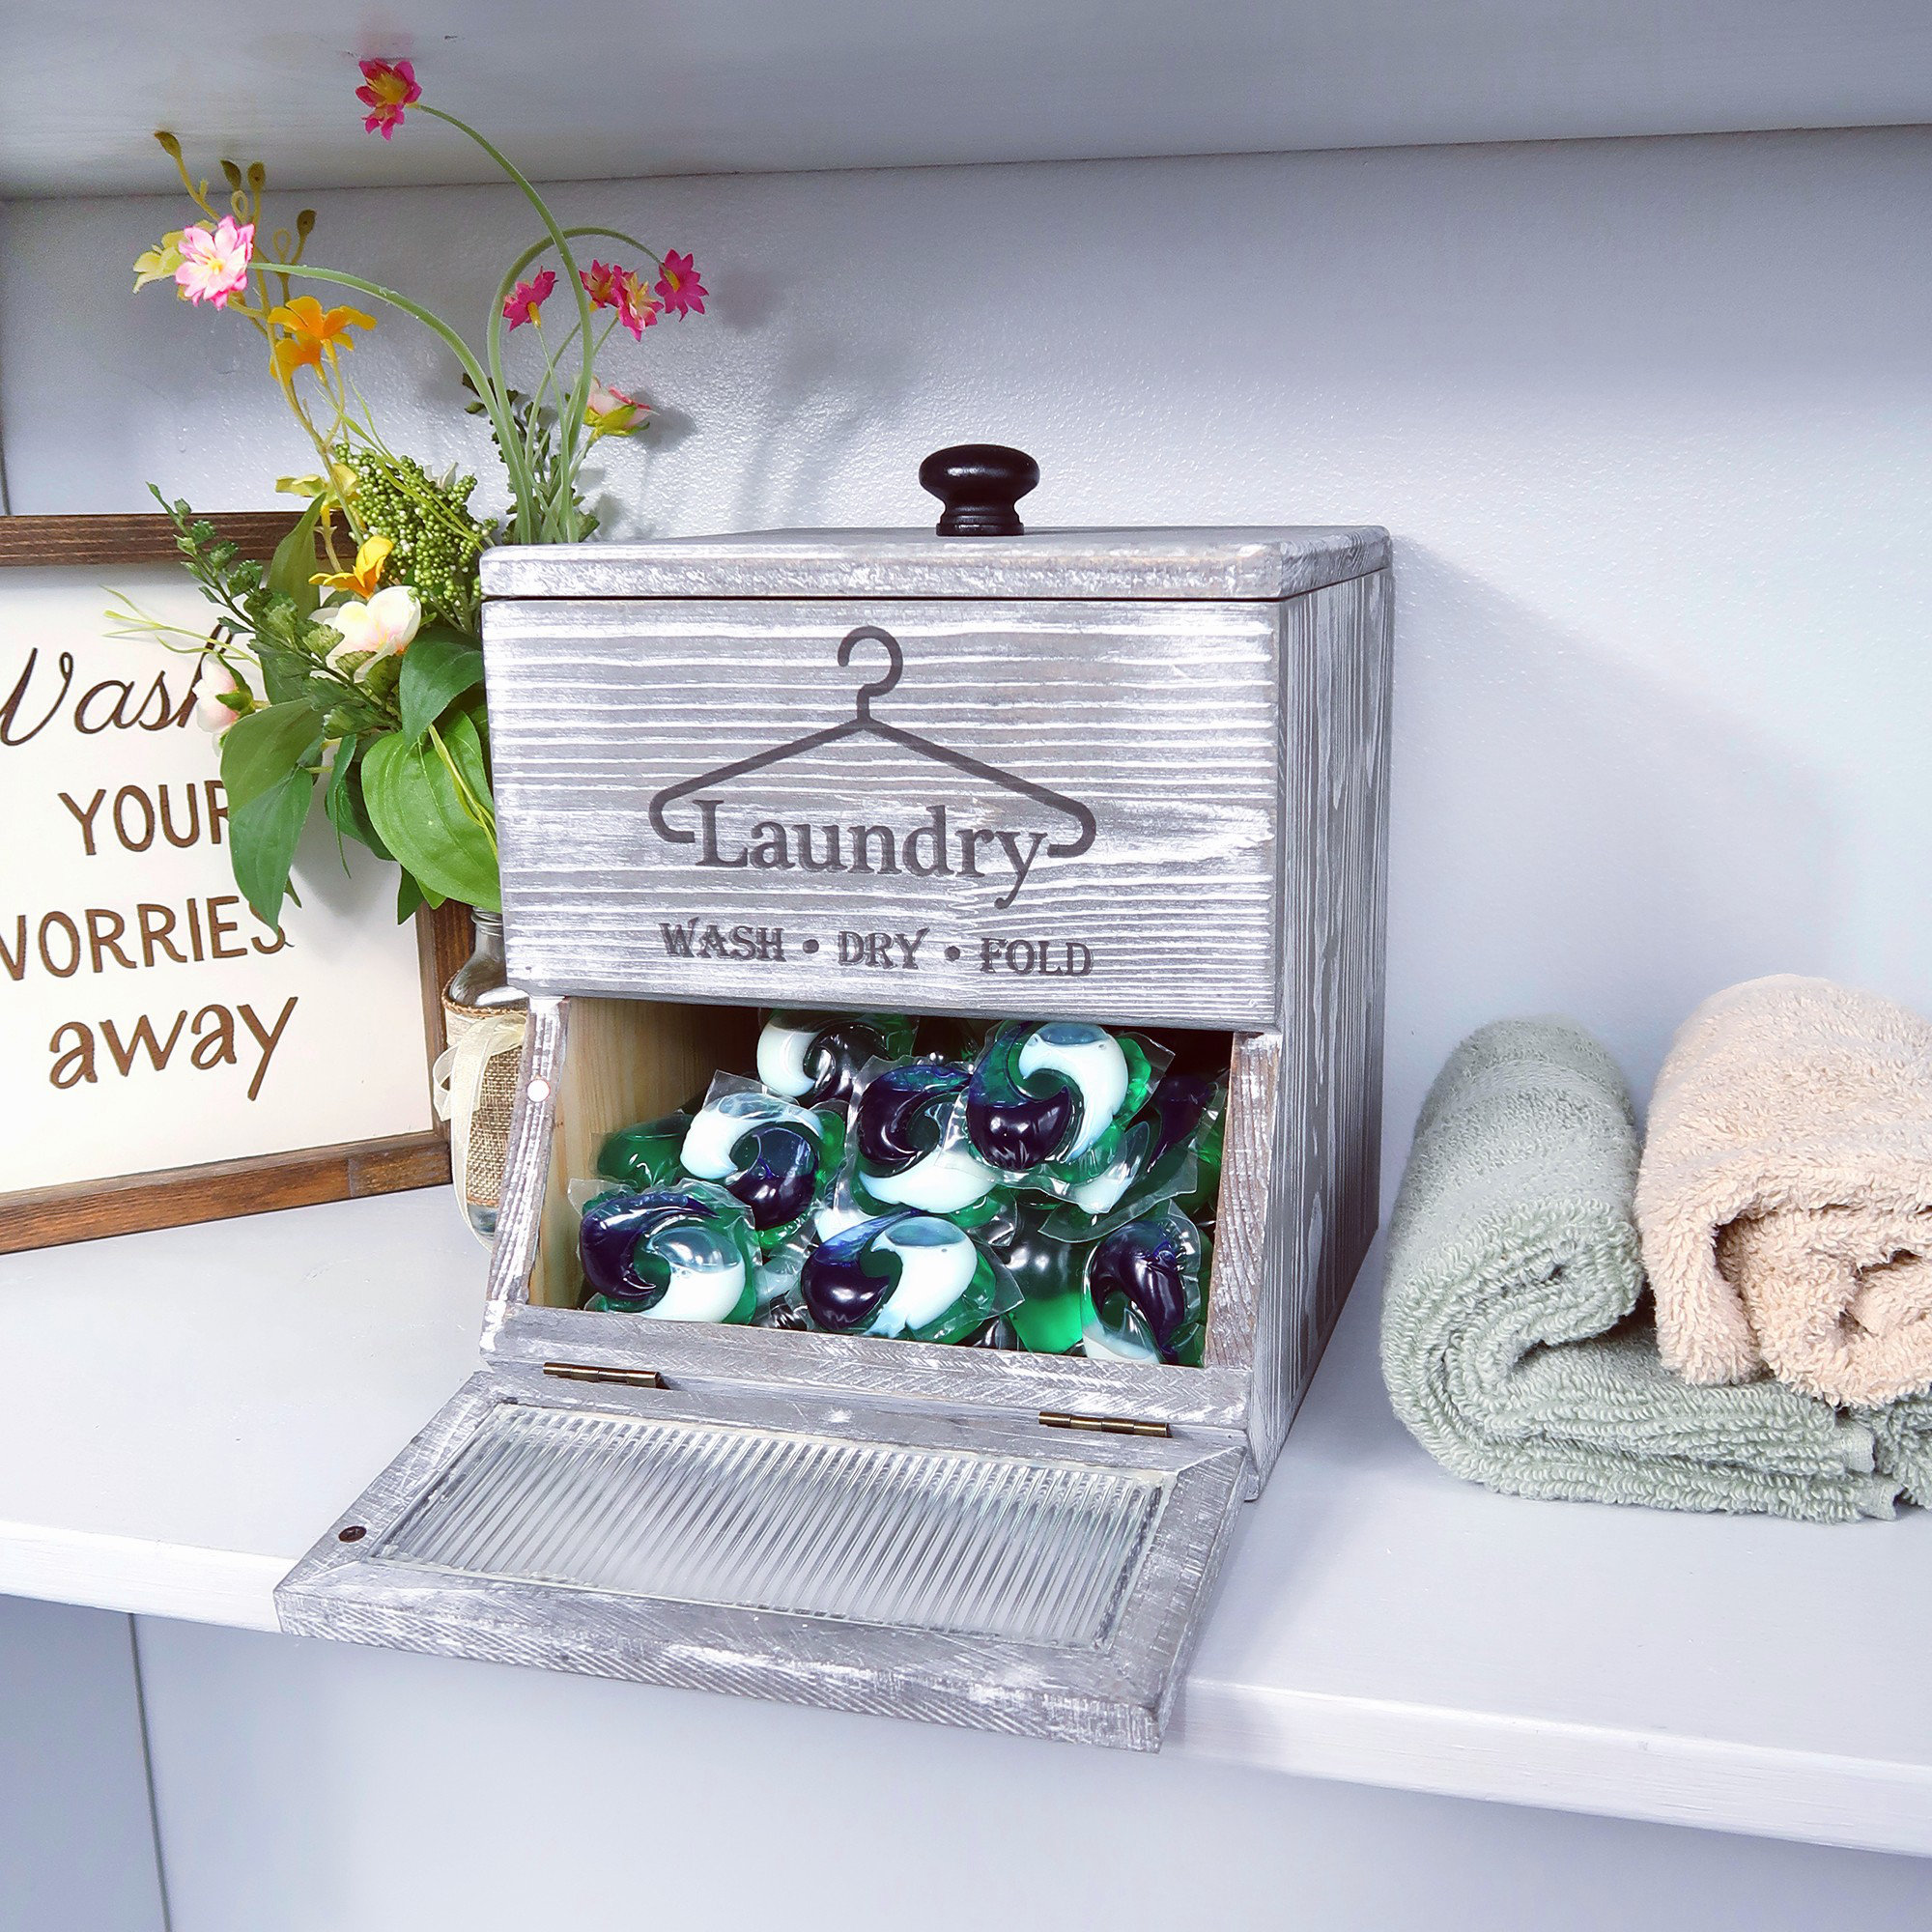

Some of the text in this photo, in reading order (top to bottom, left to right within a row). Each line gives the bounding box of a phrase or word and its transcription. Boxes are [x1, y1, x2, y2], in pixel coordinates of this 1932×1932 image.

[693, 799, 1047, 910] Laundry
[660, 917, 1094, 977] WASH DRY FOLD
[49, 997, 298, 1101] away
